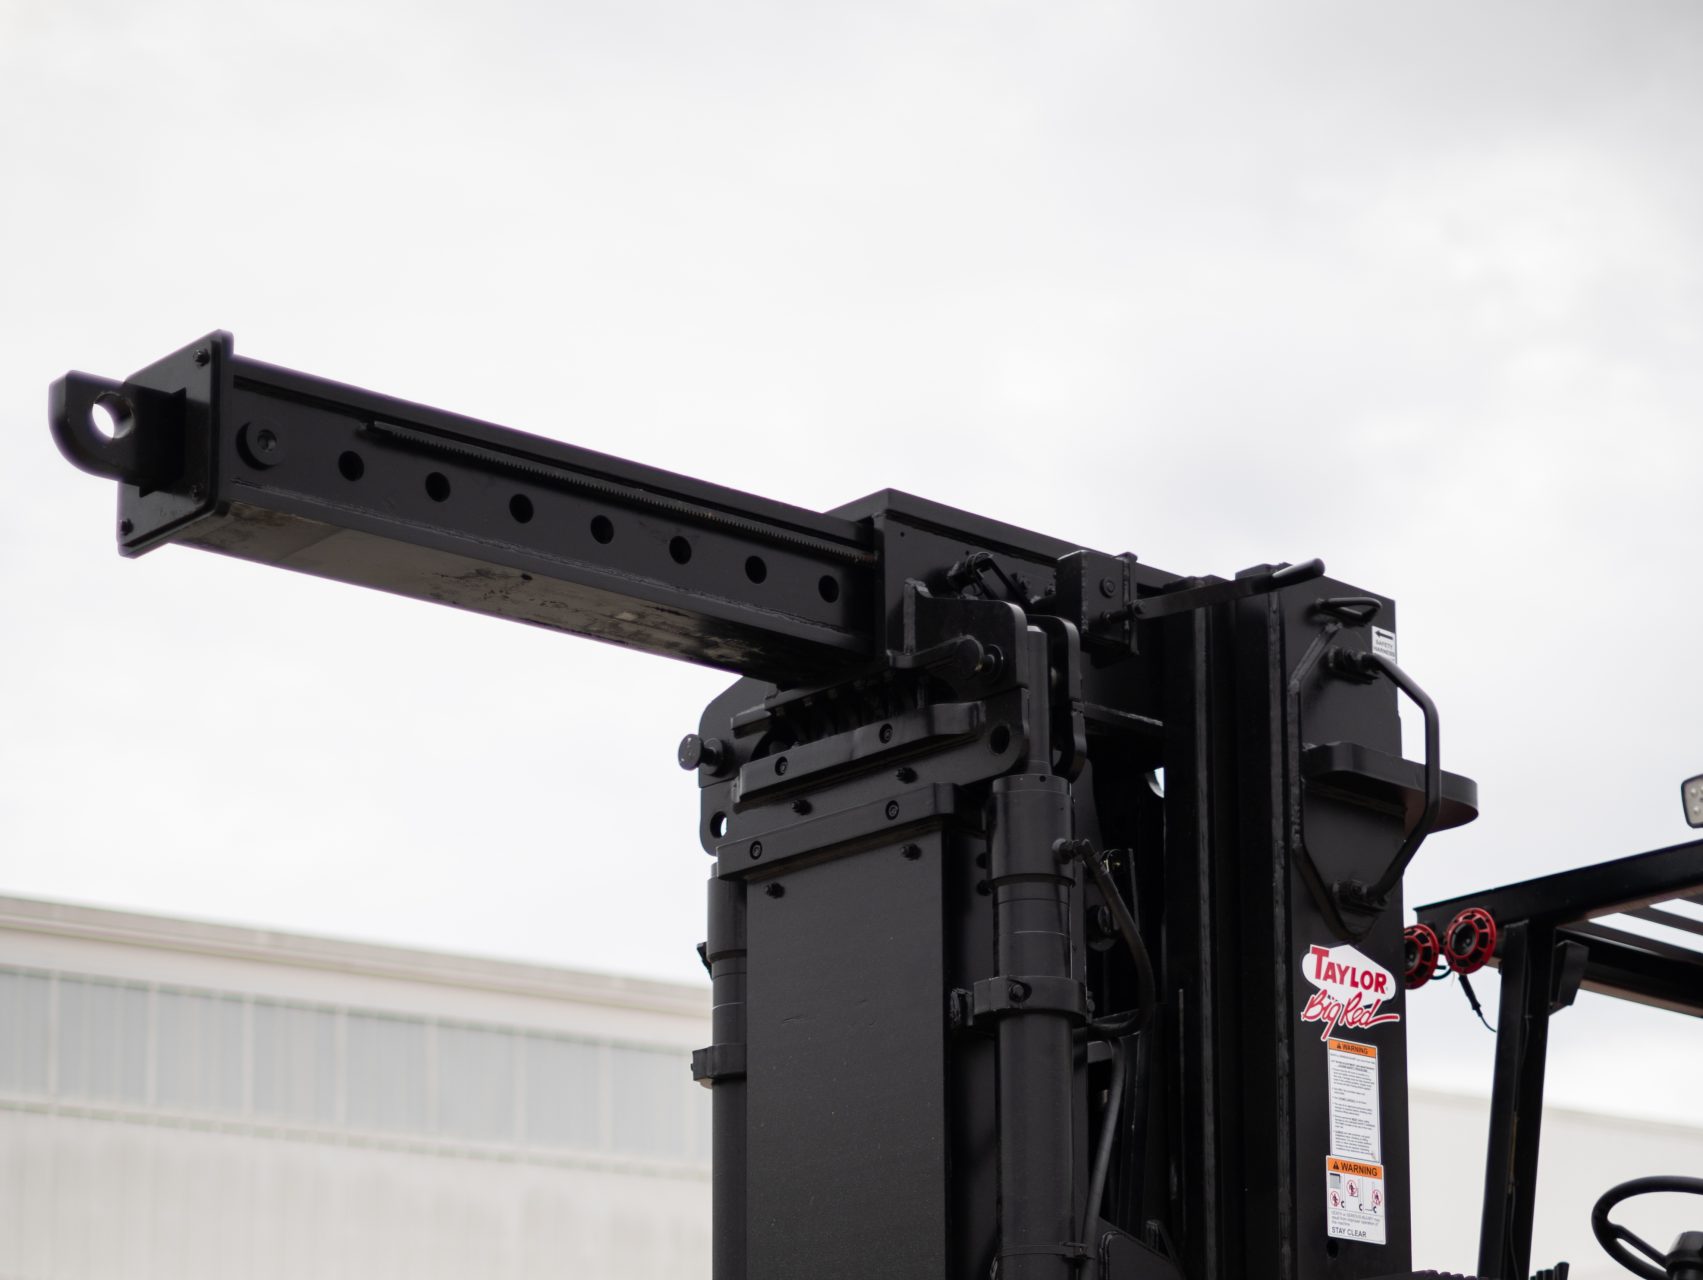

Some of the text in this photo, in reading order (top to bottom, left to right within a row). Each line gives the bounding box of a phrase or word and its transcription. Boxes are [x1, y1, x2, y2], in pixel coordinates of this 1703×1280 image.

[1311, 946, 1387, 994] TAYLOR
[1301, 989, 1400, 1041] Big Red
[1342, 1044, 1369, 1054] WARNING
[1341, 1162, 1378, 1177] WARNING
[1331, 1226, 1367, 1237] STAY CLEAR
